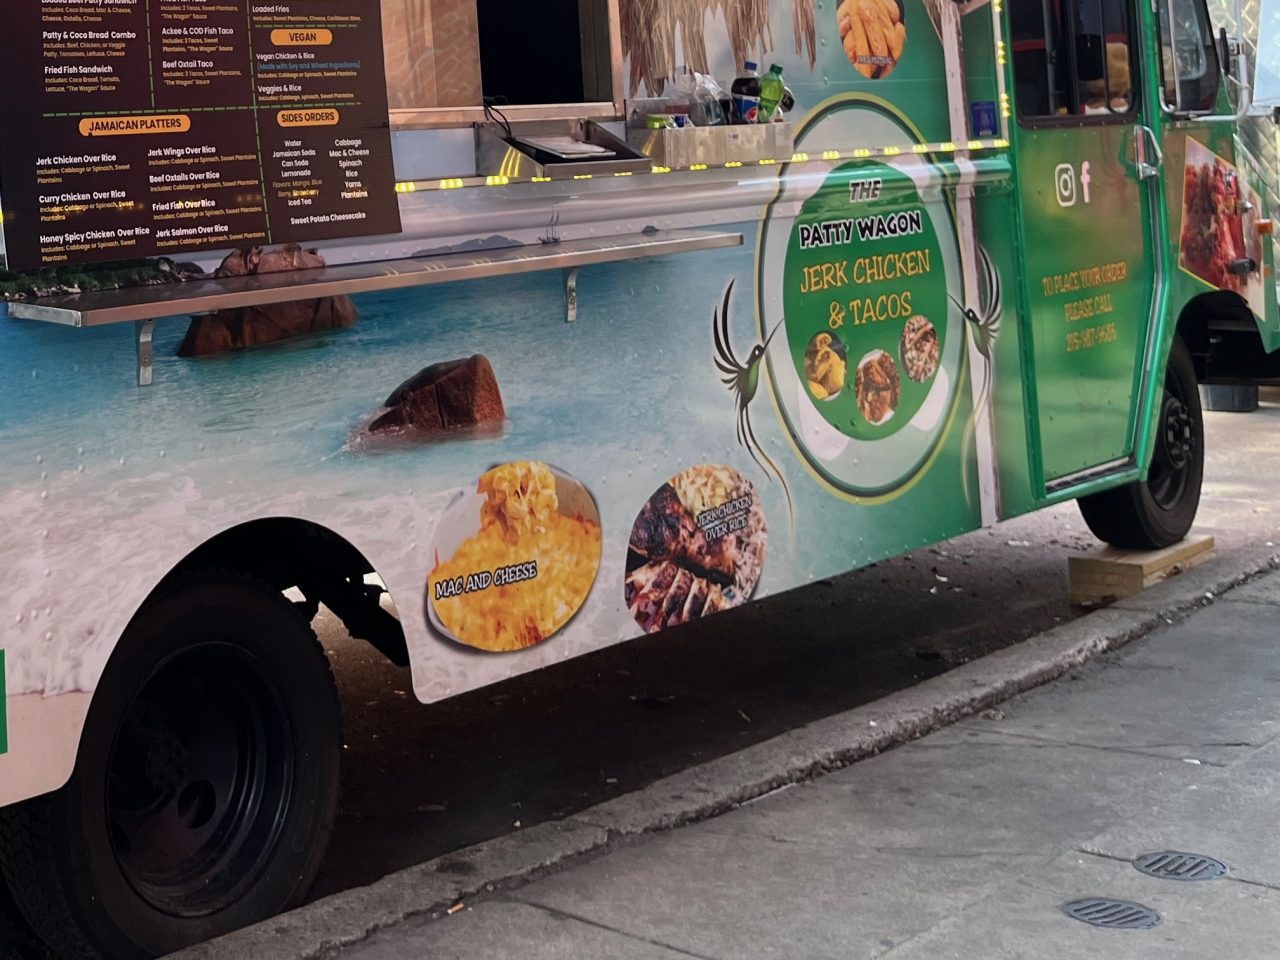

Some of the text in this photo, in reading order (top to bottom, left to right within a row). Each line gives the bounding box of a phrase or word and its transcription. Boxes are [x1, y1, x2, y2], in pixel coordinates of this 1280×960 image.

[43, 32, 61, 41] Patty
[289, 33, 316, 41] VEGAN
[256, 53, 274, 61] Vegan
[79, 65, 113, 73] Sandwich
[258, 86, 282, 94] Veggies
[282, 112, 334, 122] SIDES ORDERS
[89, 119, 181, 131] JAMAICAN PLATTERS
[335, 139, 362, 147] Cabbage
[163, 148, 184, 157] Wings
[202, 145, 216, 153] Rice
[53, 156, 82, 164] Chicken
[83, 155, 99, 163] Over
[101, 153, 116, 161] Rice
[339, 159, 362, 169] Spinach
[149, 174, 164, 183] Beef
[165, 173, 188, 182] Oxtails
[206, 171, 220, 179] Rice
[282, 169, 311, 177] Lemonade
[850, 179, 881, 201] THE
[39, 190, 125, 204] Curry Chicken Over Rice
[152, 199, 215, 211] Fried Fish Over Rice
[291, 212, 366, 225] Sweet Potato Cheesecake
[156, 230, 170, 238] Jerk
[171, 228, 197, 236] Salmon
[214, 224, 228, 232] Rice
[799, 210, 922, 248] PATTY WAGON
[40, 235, 64, 244] Honey
[65, 232, 84, 243] Spicy
[86, 230, 115, 239] Chicken
[135, 227, 149, 235] Rice
[801, 249, 930, 292] JERK CHICKEN
[829, 291, 912, 329] & TACOS
[698, 495, 751, 527] JERK CHICKEN
[706, 514, 748, 541] OVER RICE
[435, 561, 537, 599] MAC AND CHEESE
